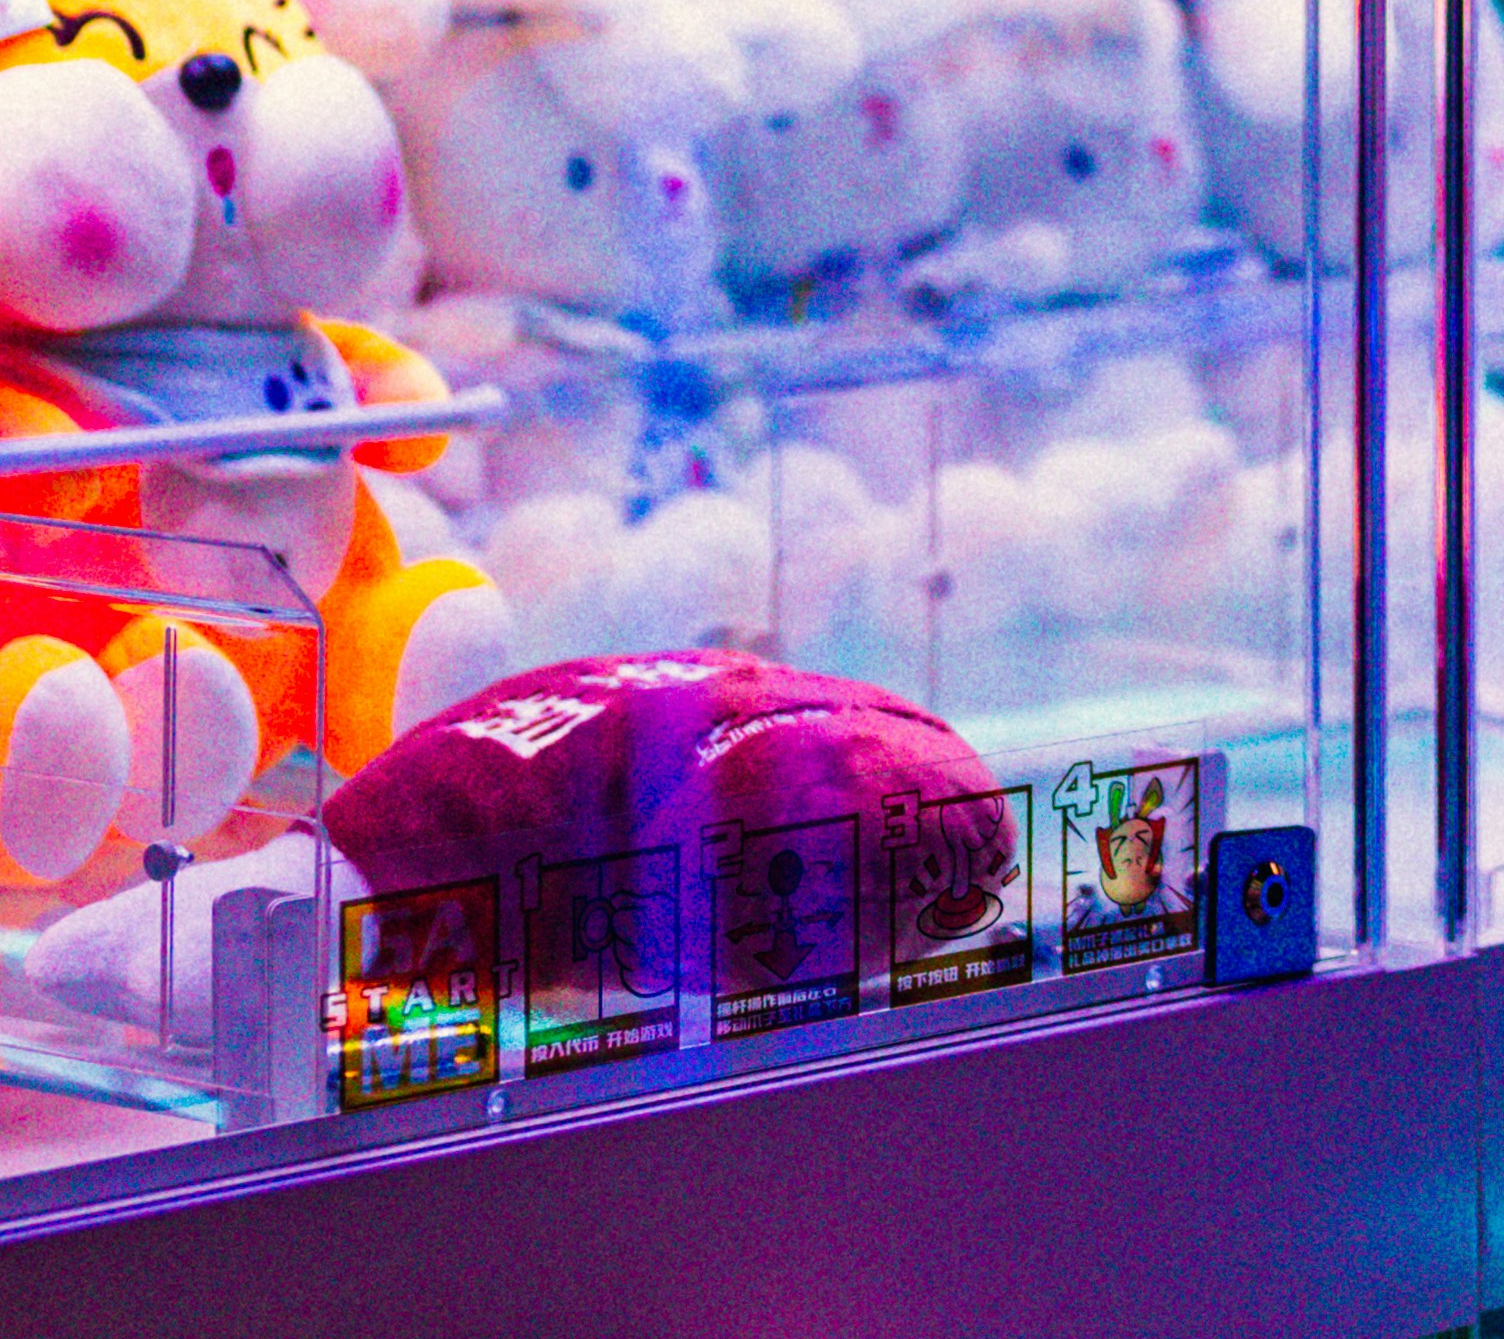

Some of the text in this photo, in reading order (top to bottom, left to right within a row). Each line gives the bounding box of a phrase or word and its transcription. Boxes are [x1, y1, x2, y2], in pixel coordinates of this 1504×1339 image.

[881, 789, 921, 851] 3
[1052, 761, 1099, 818] 4
[700, 819, 744, 881] 2
[516, 852, 542, 911] 1
[320, 958, 519, 1033] START
